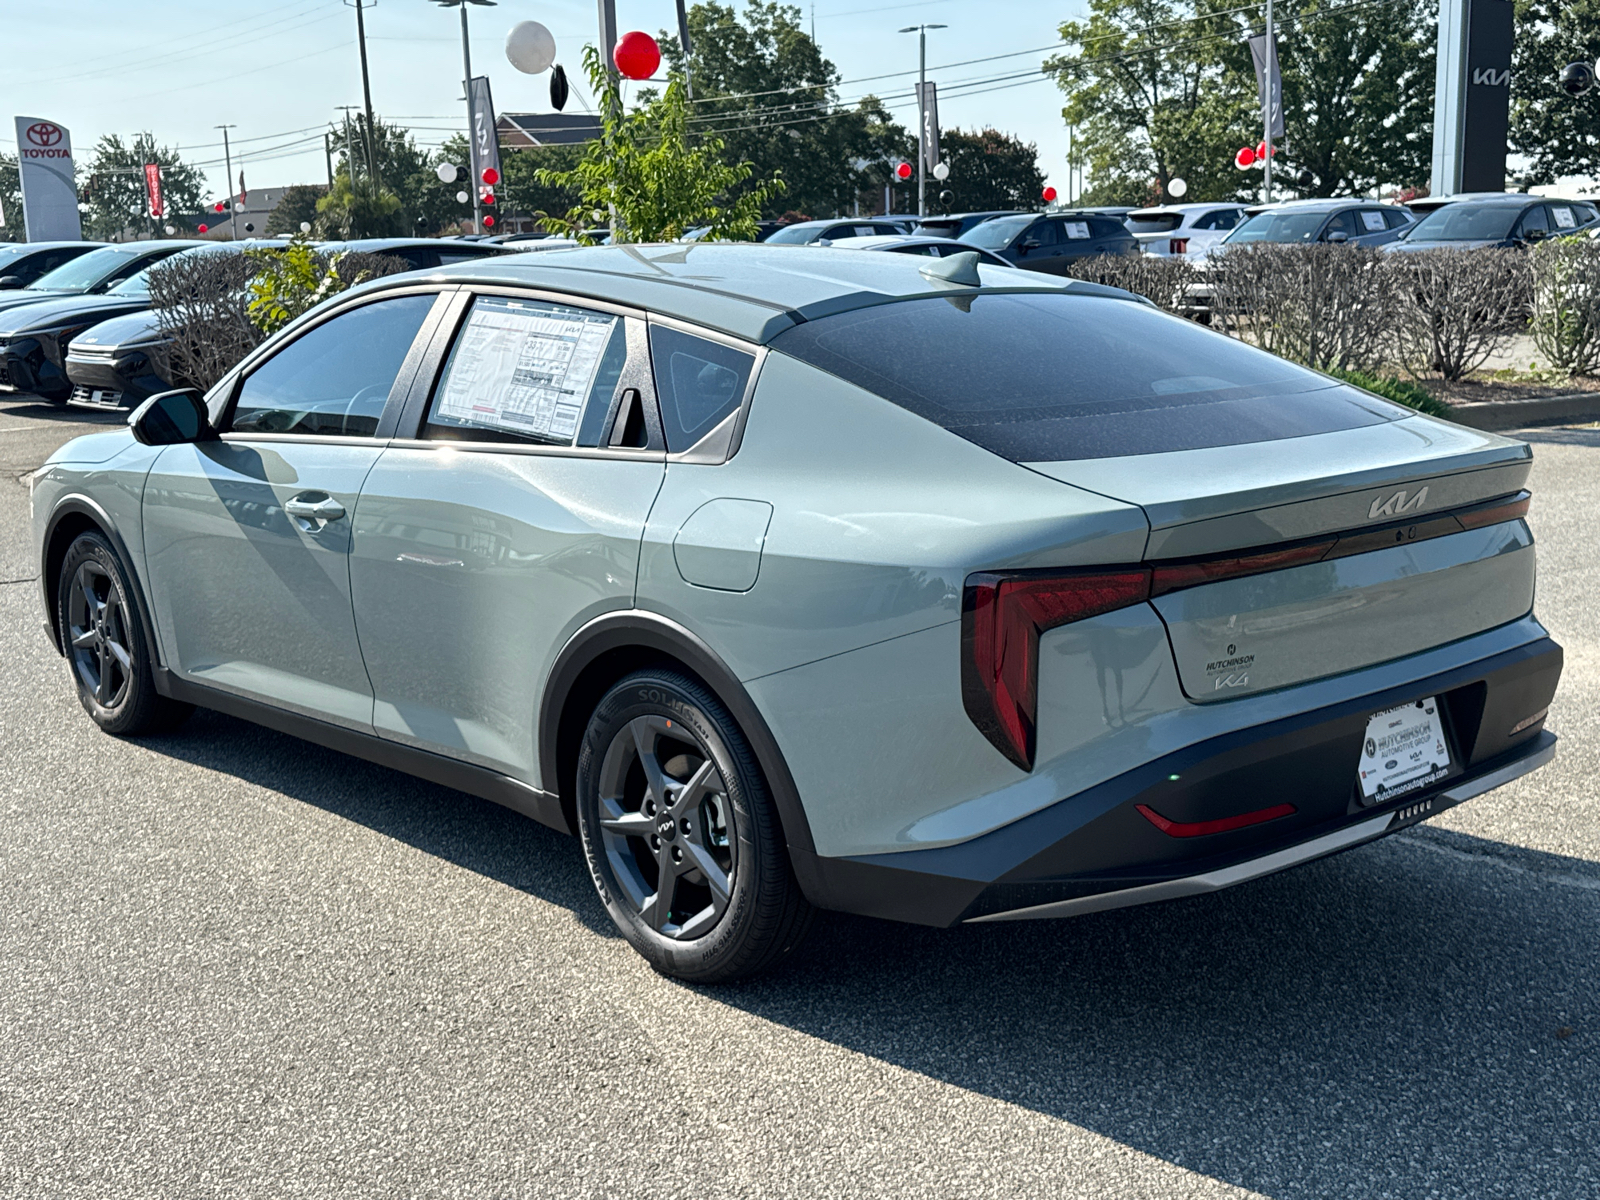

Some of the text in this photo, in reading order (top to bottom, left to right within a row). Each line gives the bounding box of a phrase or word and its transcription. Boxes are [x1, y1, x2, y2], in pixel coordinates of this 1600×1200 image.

[1473, 67, 1510, 87] KIA
[22, 149, 71, 159] TOYOTA
[1368, 486, 1429, 519] KIA
[1206, 654, 1255, 671] HUTCHINSON
[1215, 671, 1249, 691] K4
[1378, 721, 1432, 750] HUTCHINSON
[1381, 734, 1431, 759] AUTOMOTIVE GROUP
[1410, 750, 1422, 760] KIA
